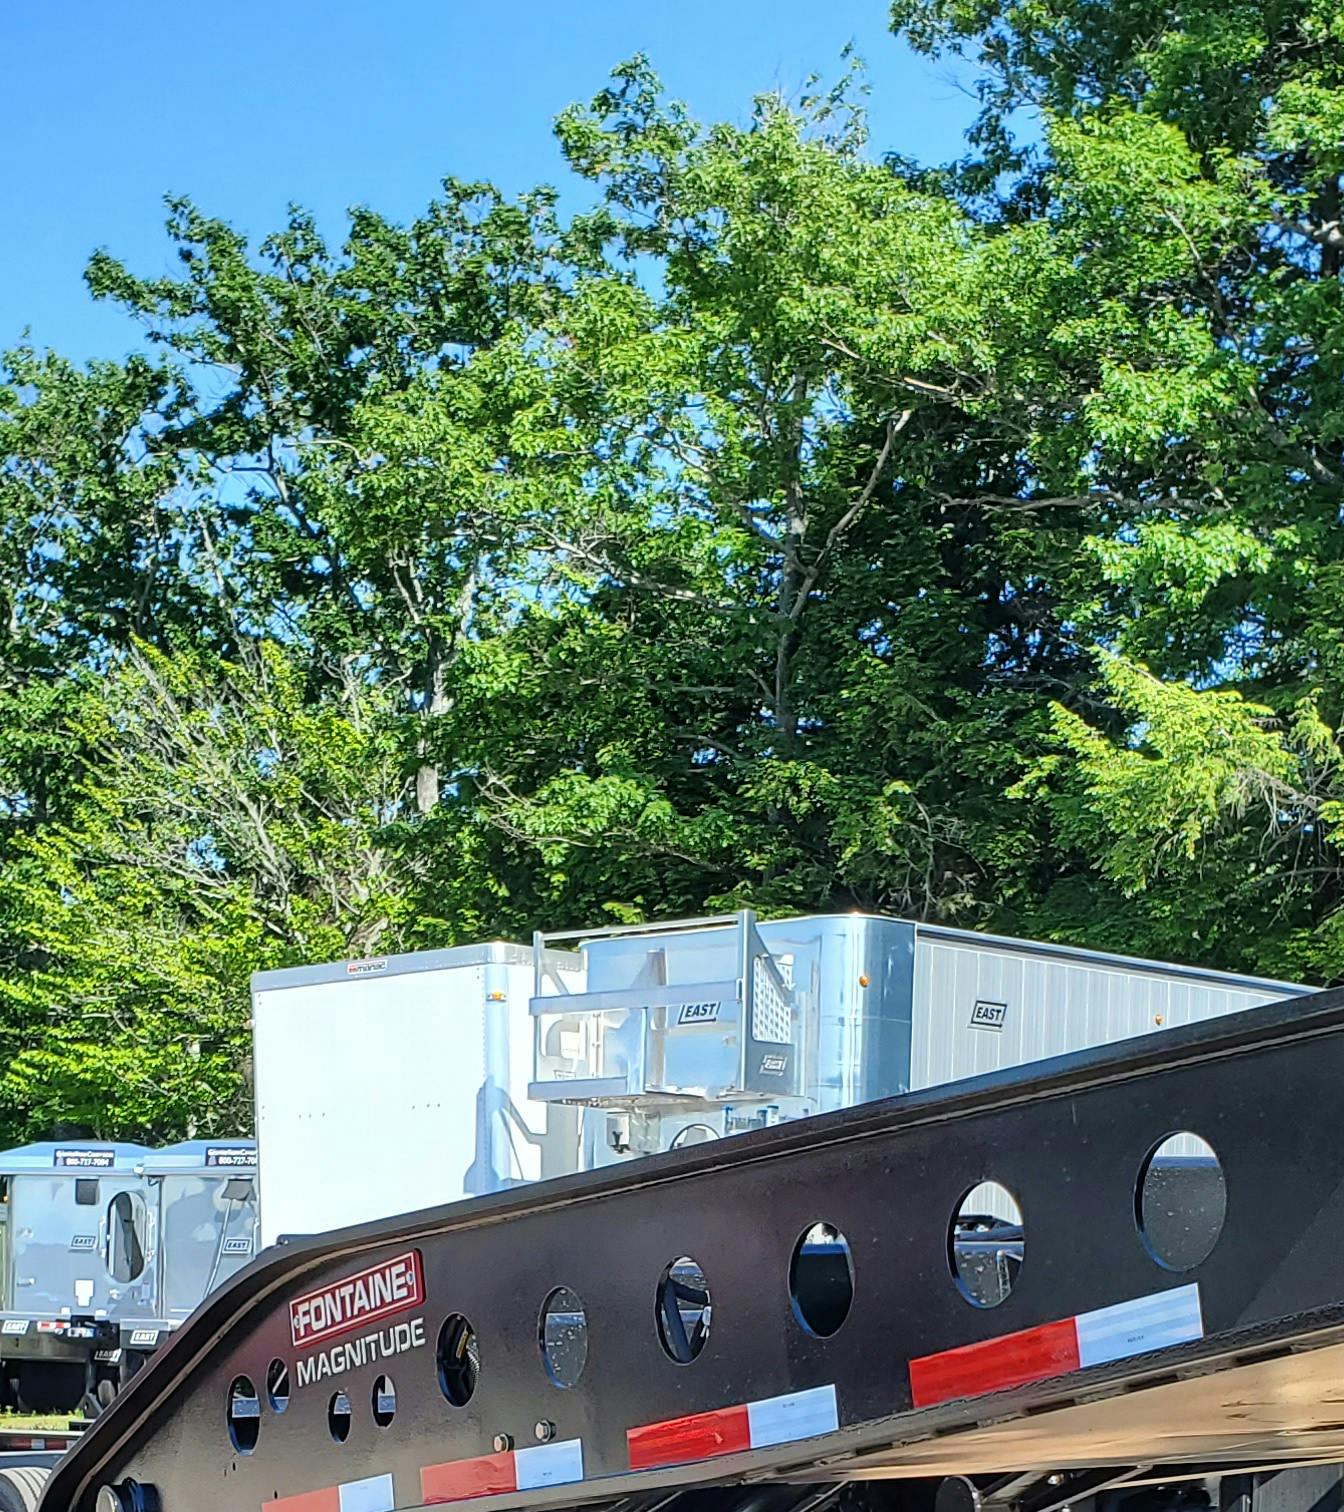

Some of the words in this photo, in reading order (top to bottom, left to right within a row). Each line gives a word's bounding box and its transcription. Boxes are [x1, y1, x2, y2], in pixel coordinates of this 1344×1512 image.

[684, 1003, 717, 1018] EAST
[976, 1006, 1002, 1021] EAST
[73, 1238, 92, 1246] EAST
[296, 1262, 408, 1337] FONTAINE
[296, 1317, 426, 1388] MAGNITUDE
